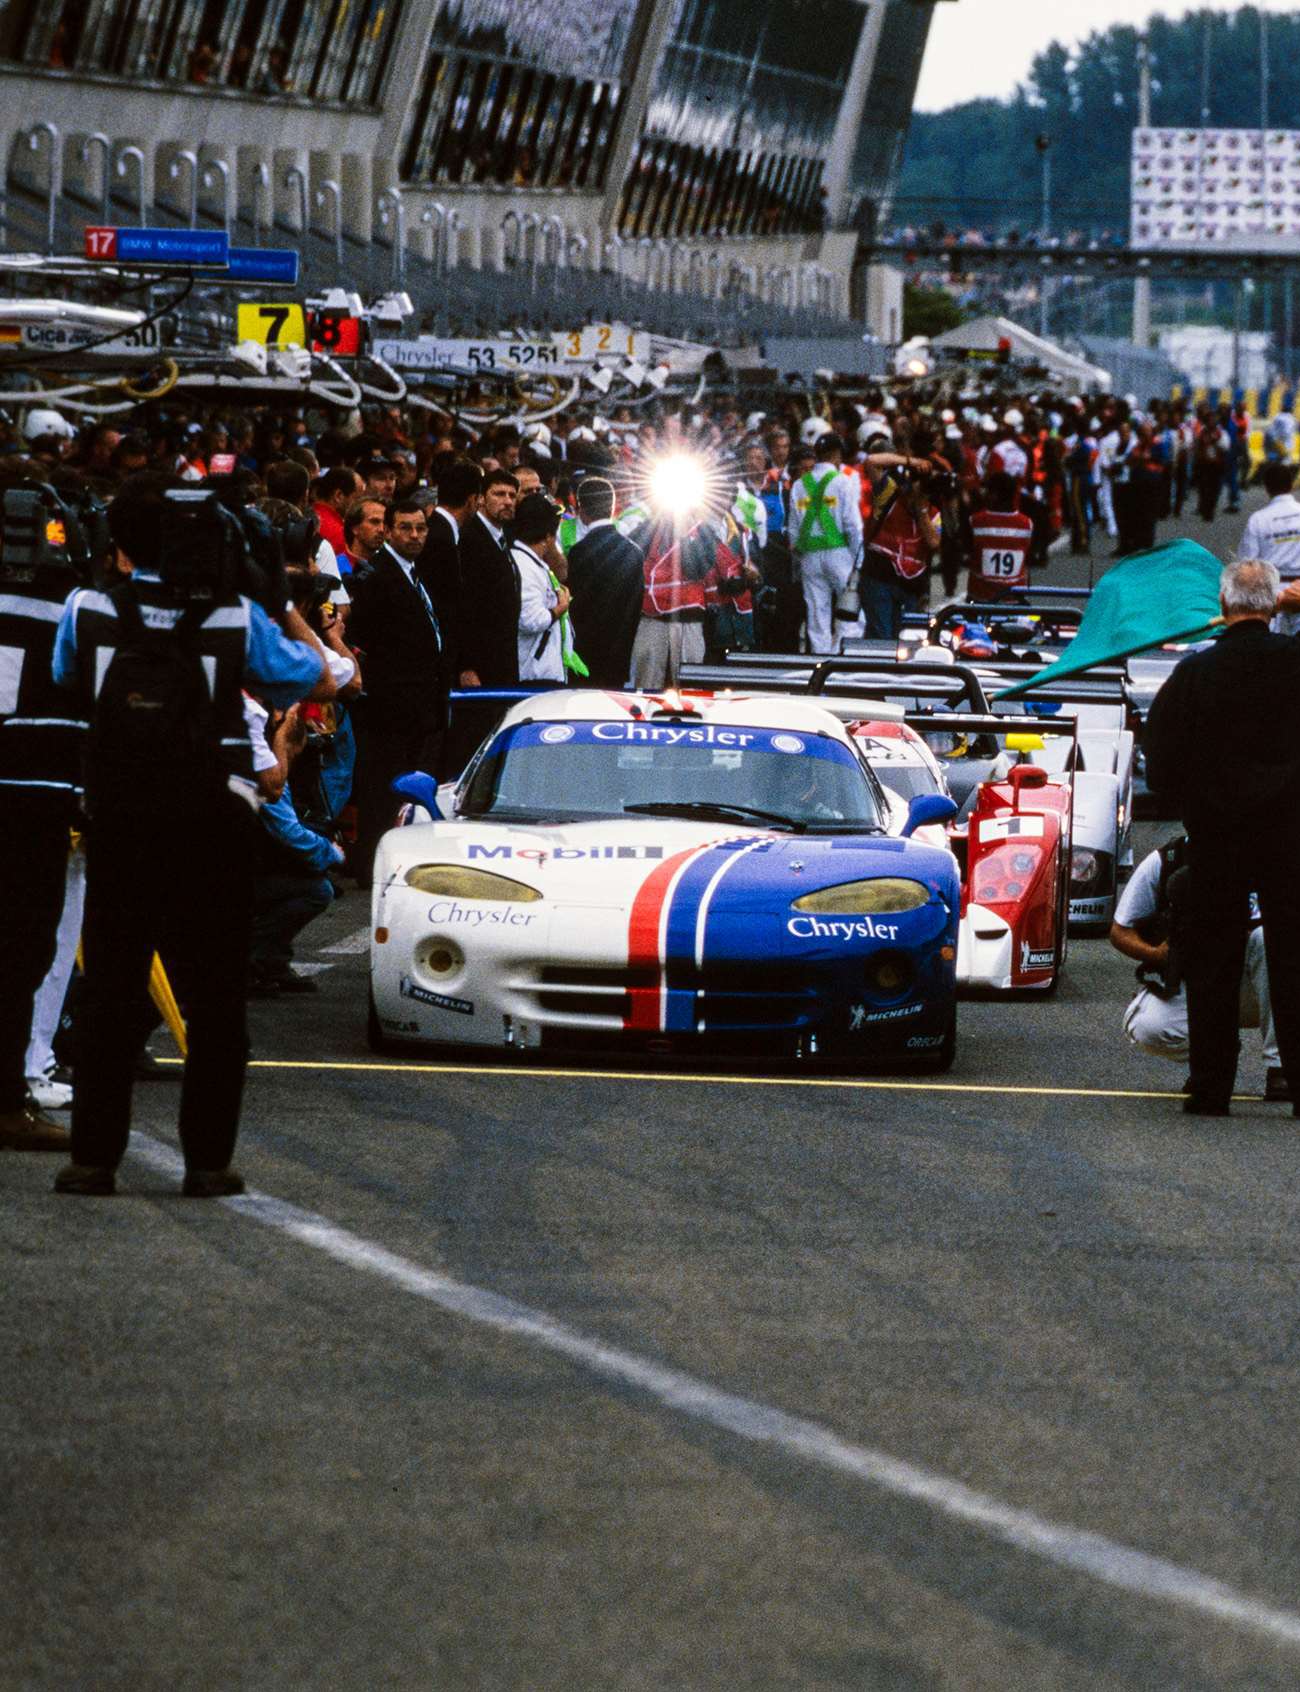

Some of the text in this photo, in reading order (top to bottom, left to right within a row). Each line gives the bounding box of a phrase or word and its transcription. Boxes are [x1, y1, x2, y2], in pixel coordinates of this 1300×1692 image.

[88, 232, 115, 254] 17
[258, 307, 290, 344] 7
[566, 330, 581, 356] 3
[597, 327, 611, 349] 2
[626, 335, 635, 356] 1
[380, 343, 453, 364] Chrysler
[467, 347, 496, 369] 53
[990, 551, 1015, 576] 19
[591, 721, 754, 747] Chrysler
[998, 818, 1021, 836] 1
[467, 845, 613, 860] Mobil
[428, 902, 537, 927] Chrysler
[1068, 903, 1105, 915] CHELIN
[787, 916, 899, 941] Chrysler
[414, 989, 472, 1011] MICHELIN
[866, 1004, 923, 1021] MICHELIN
